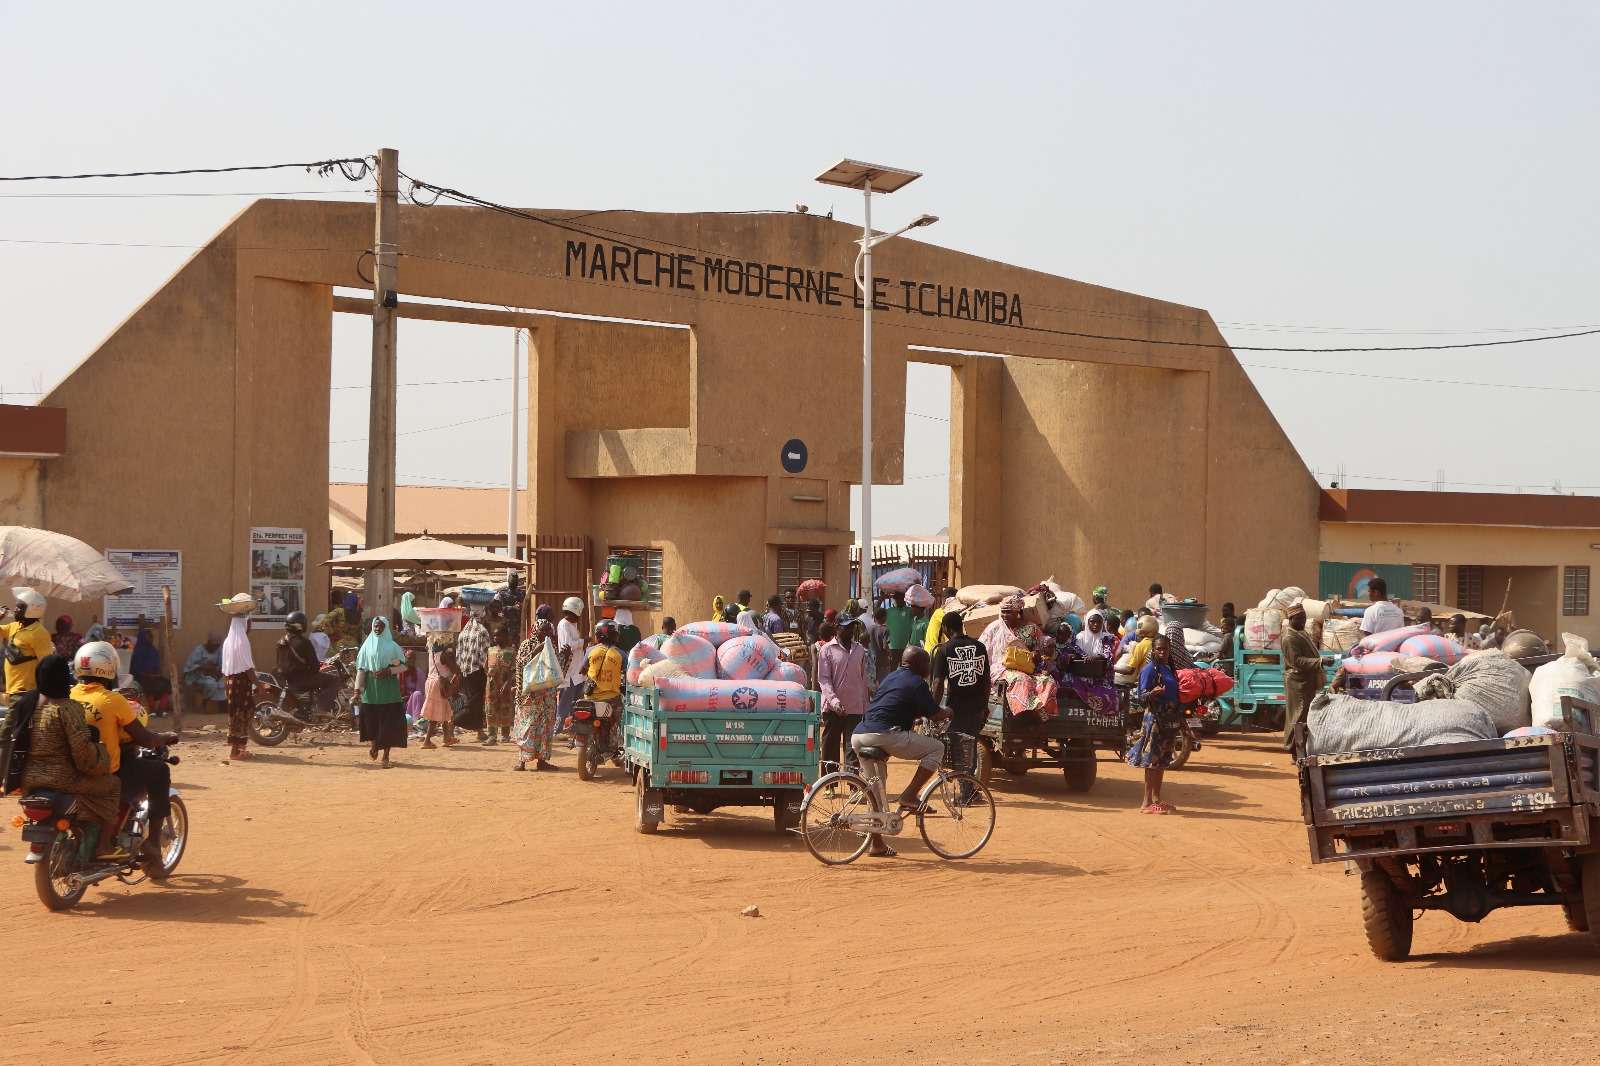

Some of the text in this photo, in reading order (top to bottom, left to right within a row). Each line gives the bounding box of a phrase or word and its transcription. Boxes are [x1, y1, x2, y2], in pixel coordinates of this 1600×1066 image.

[565, 241, 696, 290] MARCHE
[704, 257, 843, 306] MODERNE
[900, 280, 1024, 326] TCHAMBA
